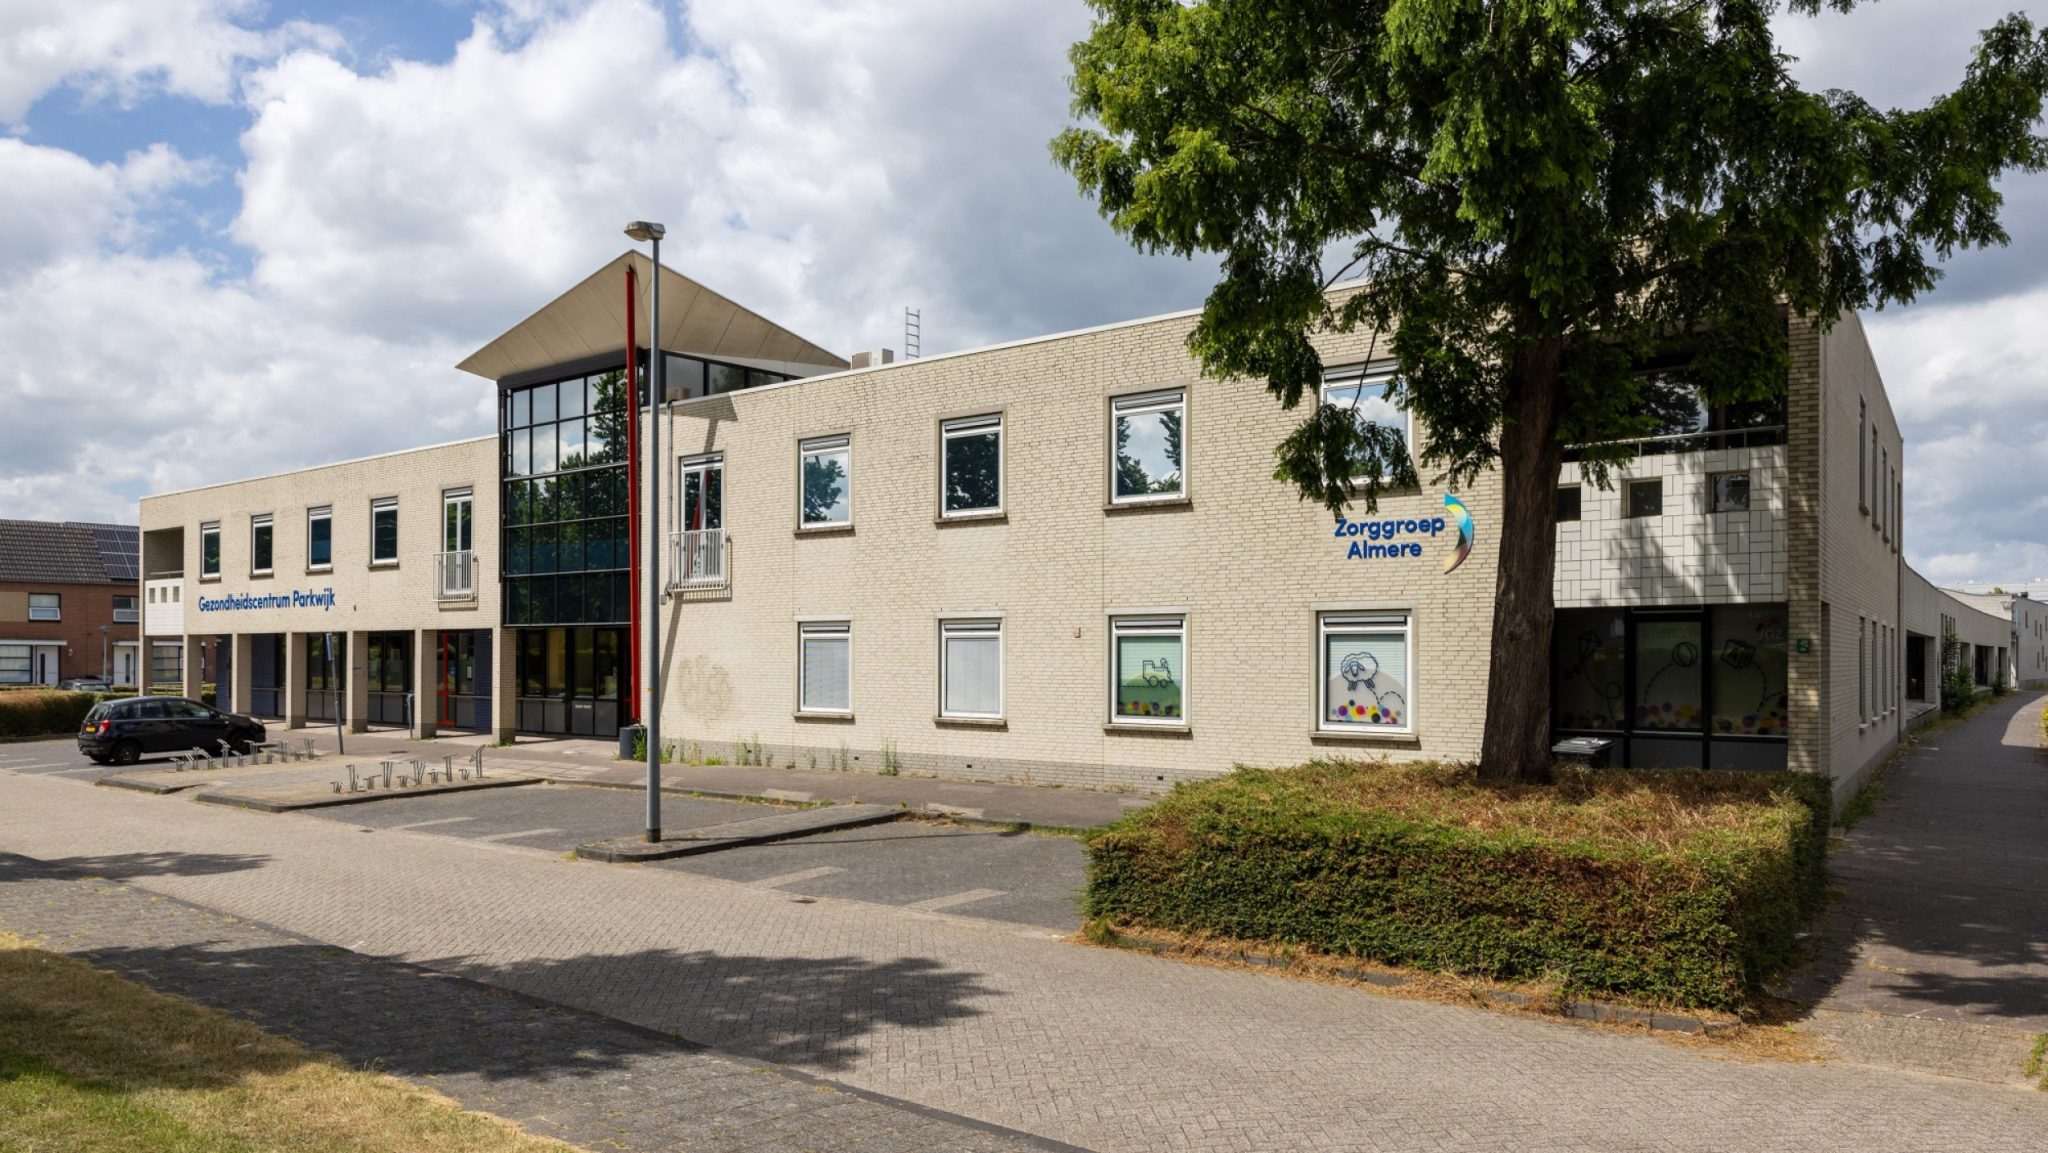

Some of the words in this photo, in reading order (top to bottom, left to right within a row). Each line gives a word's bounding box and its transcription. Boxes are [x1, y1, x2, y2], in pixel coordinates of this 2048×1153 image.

[1334, 517, 1446, 540] Zorggroep
[1347, 540, 1422, 560] Almere
[199, 593, 290, 612] Gezondheidscentrum
[293, 587, 336, 612] Parkwijk
